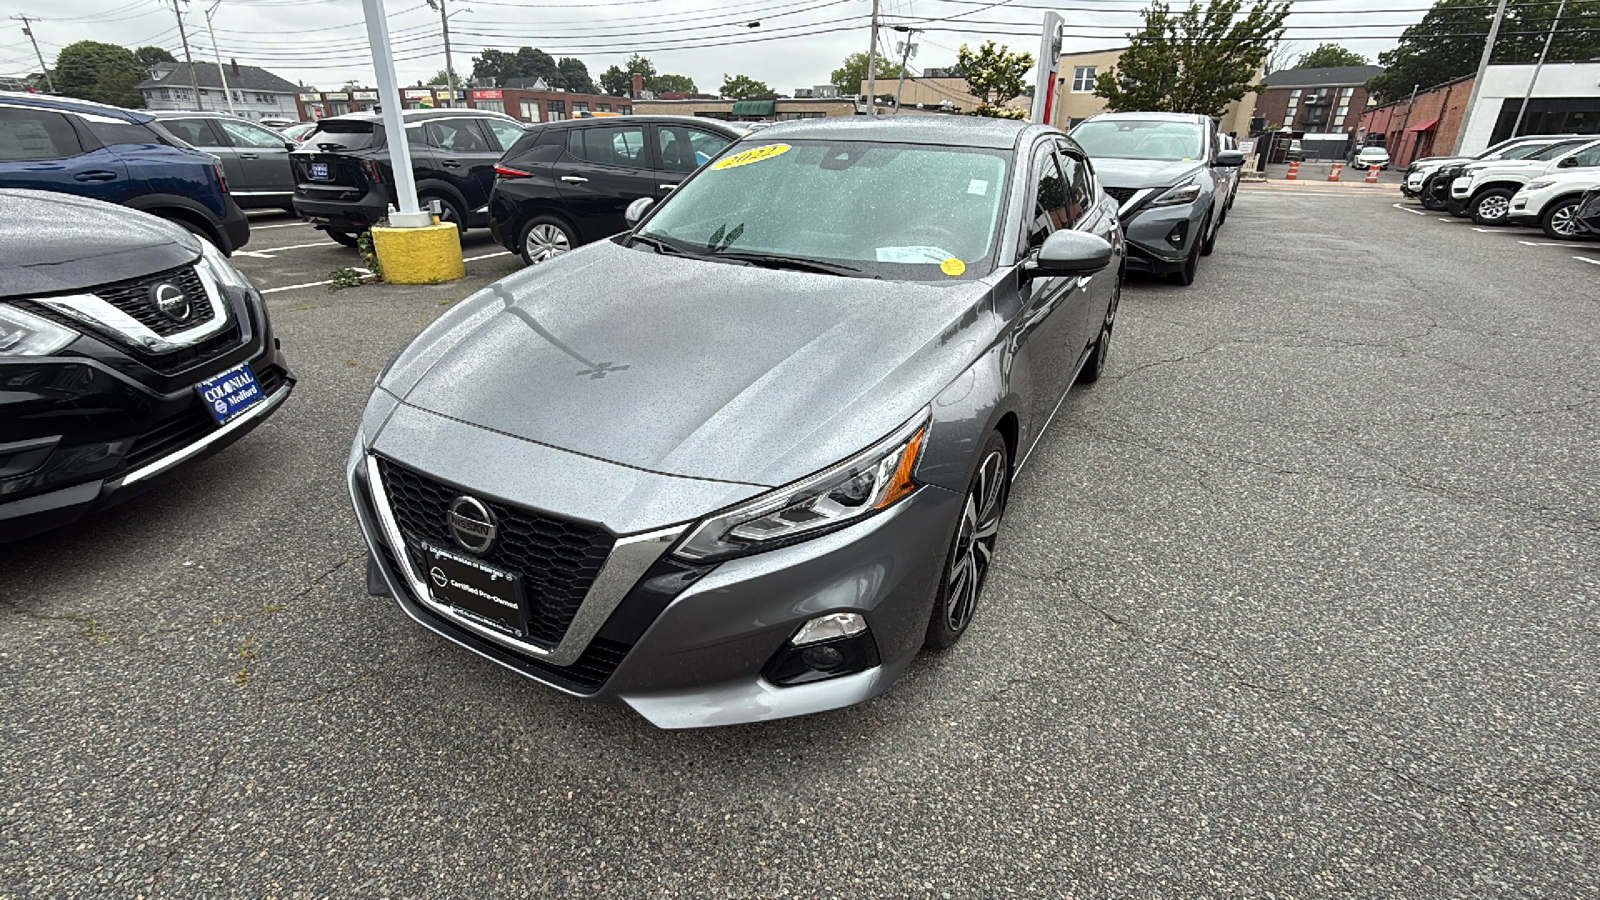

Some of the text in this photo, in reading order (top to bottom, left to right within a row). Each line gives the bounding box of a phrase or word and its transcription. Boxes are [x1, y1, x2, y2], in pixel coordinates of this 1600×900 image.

[723, 146, 778, 167] 2022
[205, 372, 254, 403] COLONIAL
[227, 384, 258, 406] Medford
[451, 517, 489, 535] NISSAN
[450, 579, 519, 609] Certified Pre-Owned
